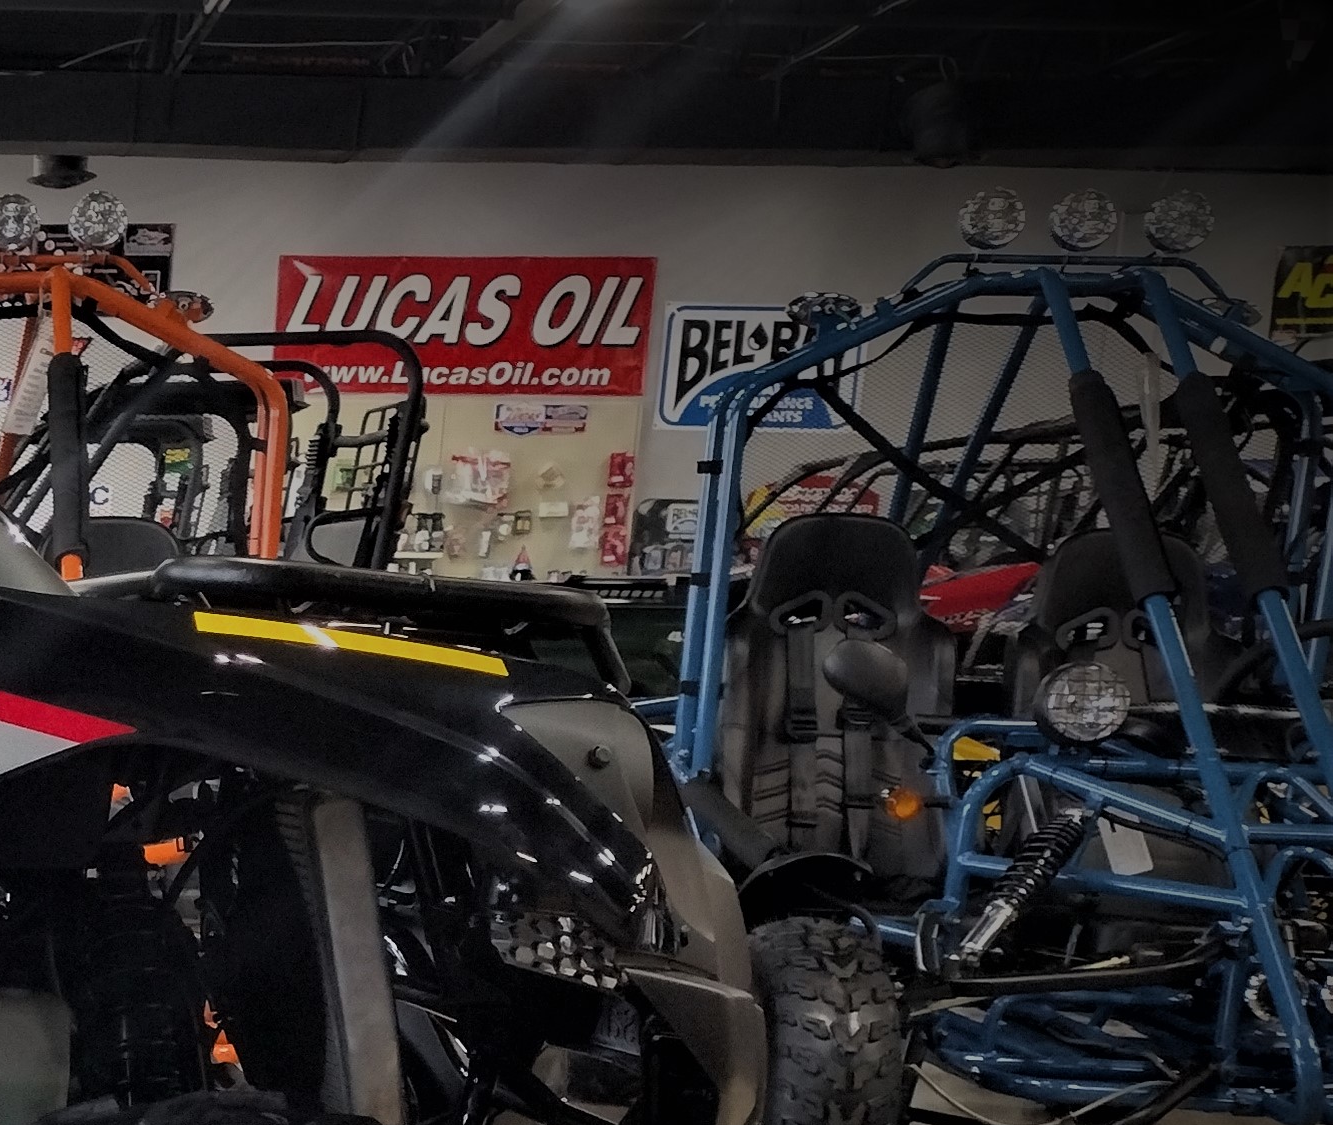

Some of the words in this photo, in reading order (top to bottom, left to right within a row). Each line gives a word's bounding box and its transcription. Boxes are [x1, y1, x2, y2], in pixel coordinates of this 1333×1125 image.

[284, 274, 522, 346] LUCAS
[532, 274, 644, 346] OIL
[304, 361, 611, 387] ww.LcasOil.com
